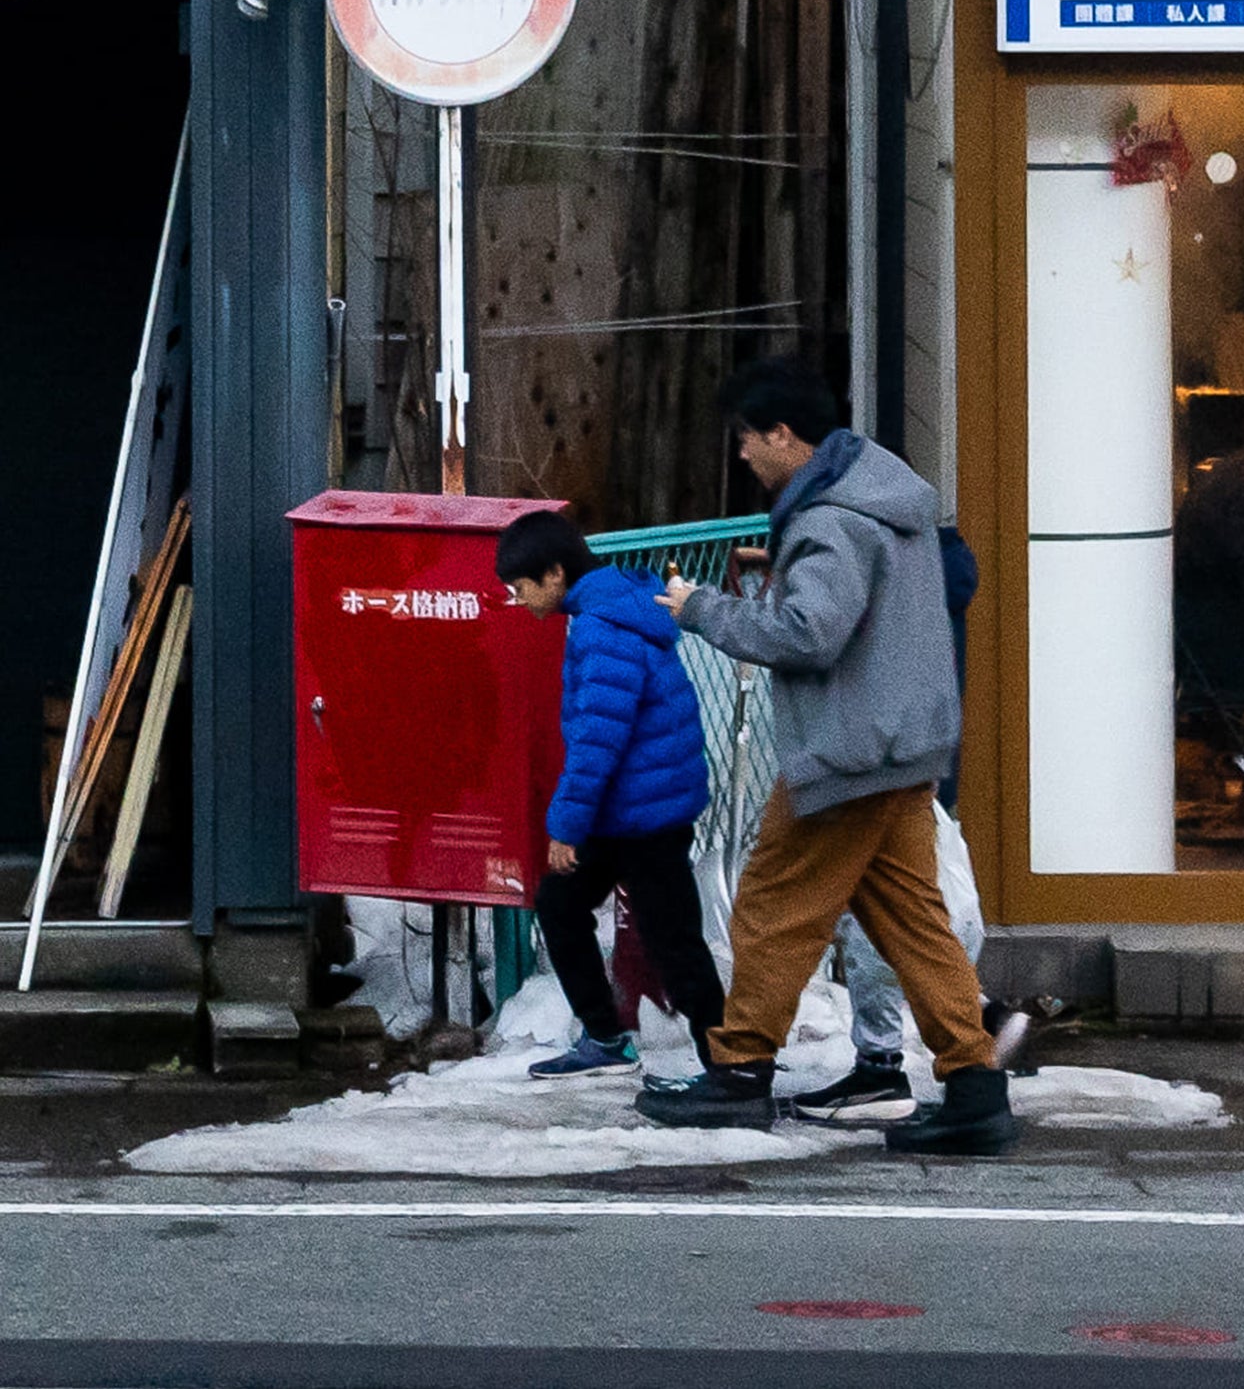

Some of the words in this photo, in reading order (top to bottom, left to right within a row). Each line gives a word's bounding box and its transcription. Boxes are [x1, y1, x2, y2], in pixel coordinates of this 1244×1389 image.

[341, 590, 480, 620] ホース格納箱
